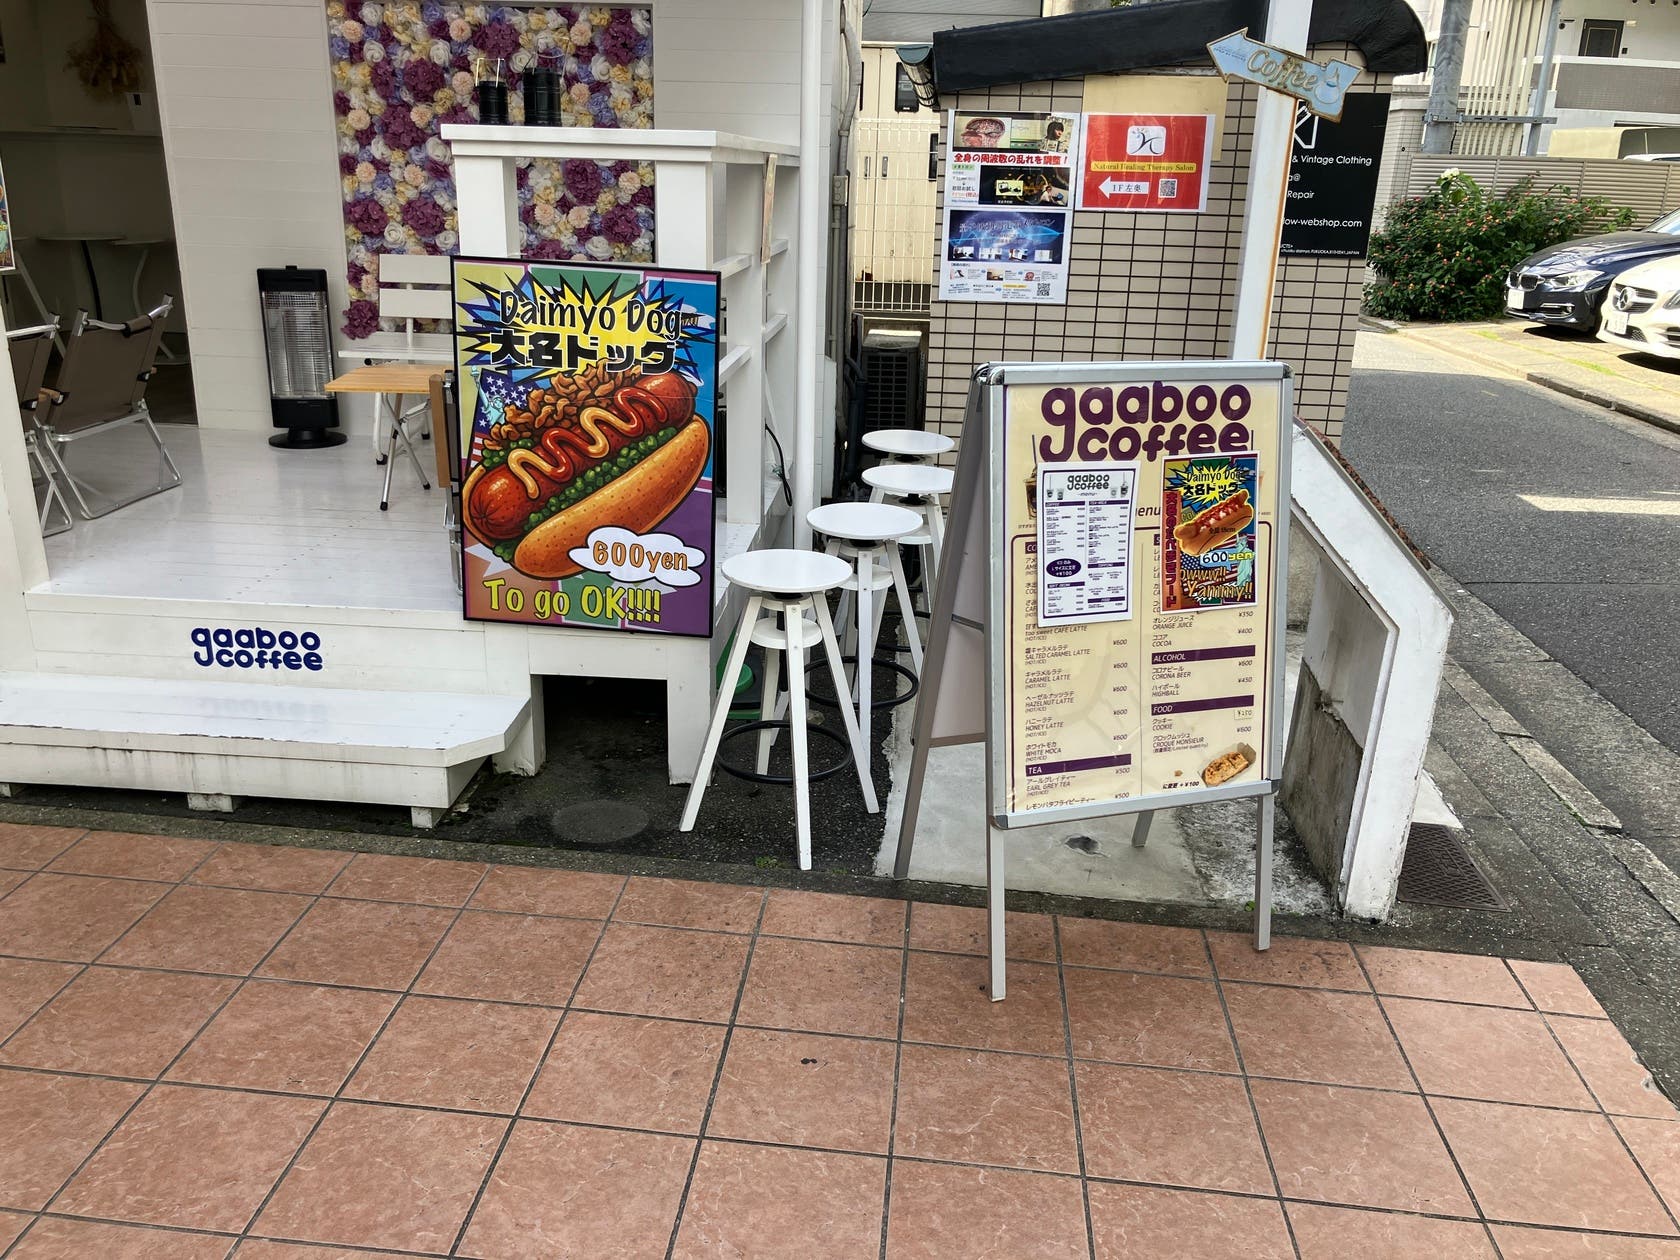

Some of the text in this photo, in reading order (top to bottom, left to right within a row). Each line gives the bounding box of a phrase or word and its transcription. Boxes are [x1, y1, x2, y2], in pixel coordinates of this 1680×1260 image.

[1247, 49, 1318, 90] Coffee
[1301, 155, 1334, 166] Vintage
[1336, 156, 1372, 166] Clothing
[1120, 164, 1145, 172] Healing
[1148, 164, 1174, 172] Therapy
[1287, 190, 1315, 200] Repair
[500, 290, 682, 341] Daimyo Dog
[490, 329, 677, 375] 大名ドッグ
[1040, 381, 1251, 462] gaaboo
[1077, 422, 1250, 462] coffee
[1067, 474, 1110, 490] gaaboo
[1186, 469, 1221, 483] Daimyo
[1074, 482, 1110, 490] coffee
[1183, 481, 1239, 496] 大名ドッグ
[1135, 506, 1160, 516] enu
[593, 541, 688, 573] 600yen
[1187, 581, 1253, 601] Yammy!!
[483, 578, 661, 623] To go OK!!!!
[1153, 615, 1194, 624] オレンジジュース
[191, 627, 321, 667] gaaboo
[215, 649, 323, 671] coffee
[1025, 652, 1046, 660] SALTED
[1154, 653, 1186, 662] ALCOHOL
[1152, 666, 1184, 674] コロナビール
[1026, 699, 1055, 708] HAZELNUT
[1153, 705, 1173, 713] FOOD
[1176, 736, 1204, 745] MONSIEUR
[1028, 767, 1042, 775] TEA
